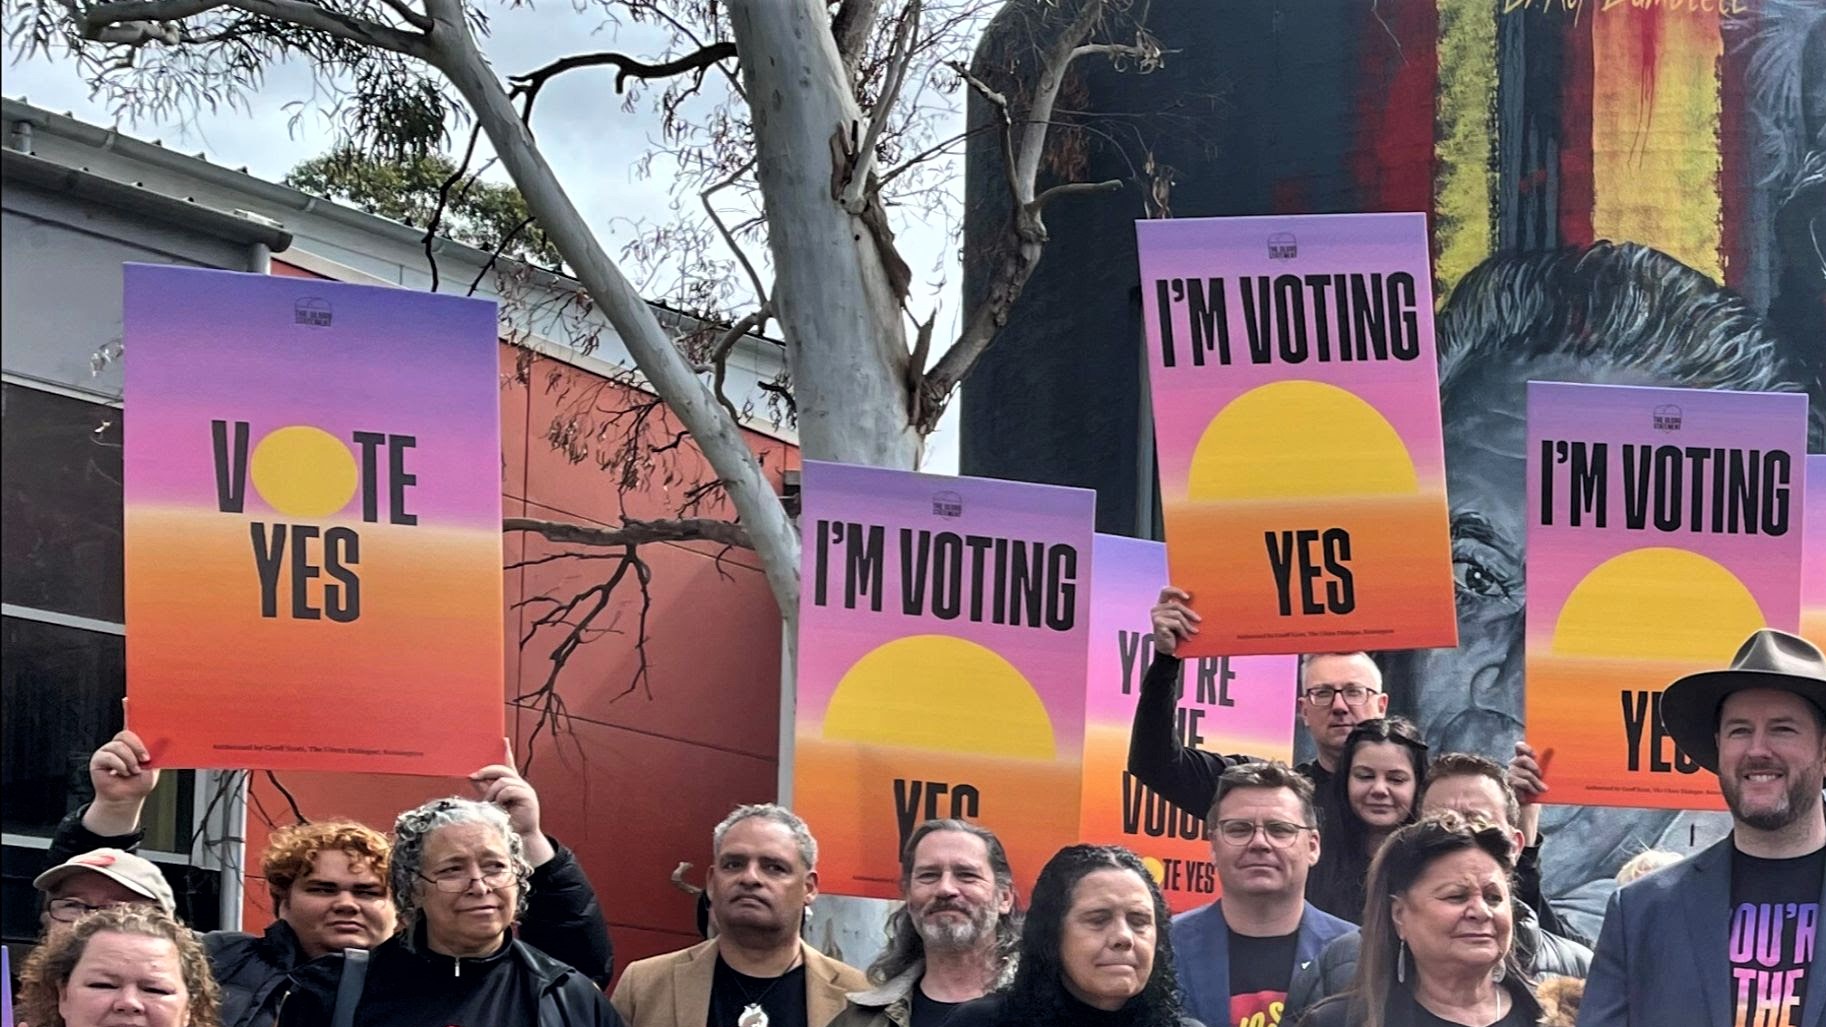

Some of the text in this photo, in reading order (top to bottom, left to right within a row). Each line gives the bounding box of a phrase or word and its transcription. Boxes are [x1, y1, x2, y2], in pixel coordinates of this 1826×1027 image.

[1157, 271, 1420, 367] I'M VOTING
[1540, 440, 1791, 536] I'M VOTING
[251, 522, 361, 622] YES
[815, 519, 1078, 632] I'M VOTING
[1264, 527, 1356, 617] YES
[1185, 860, 1215, 895] YES
